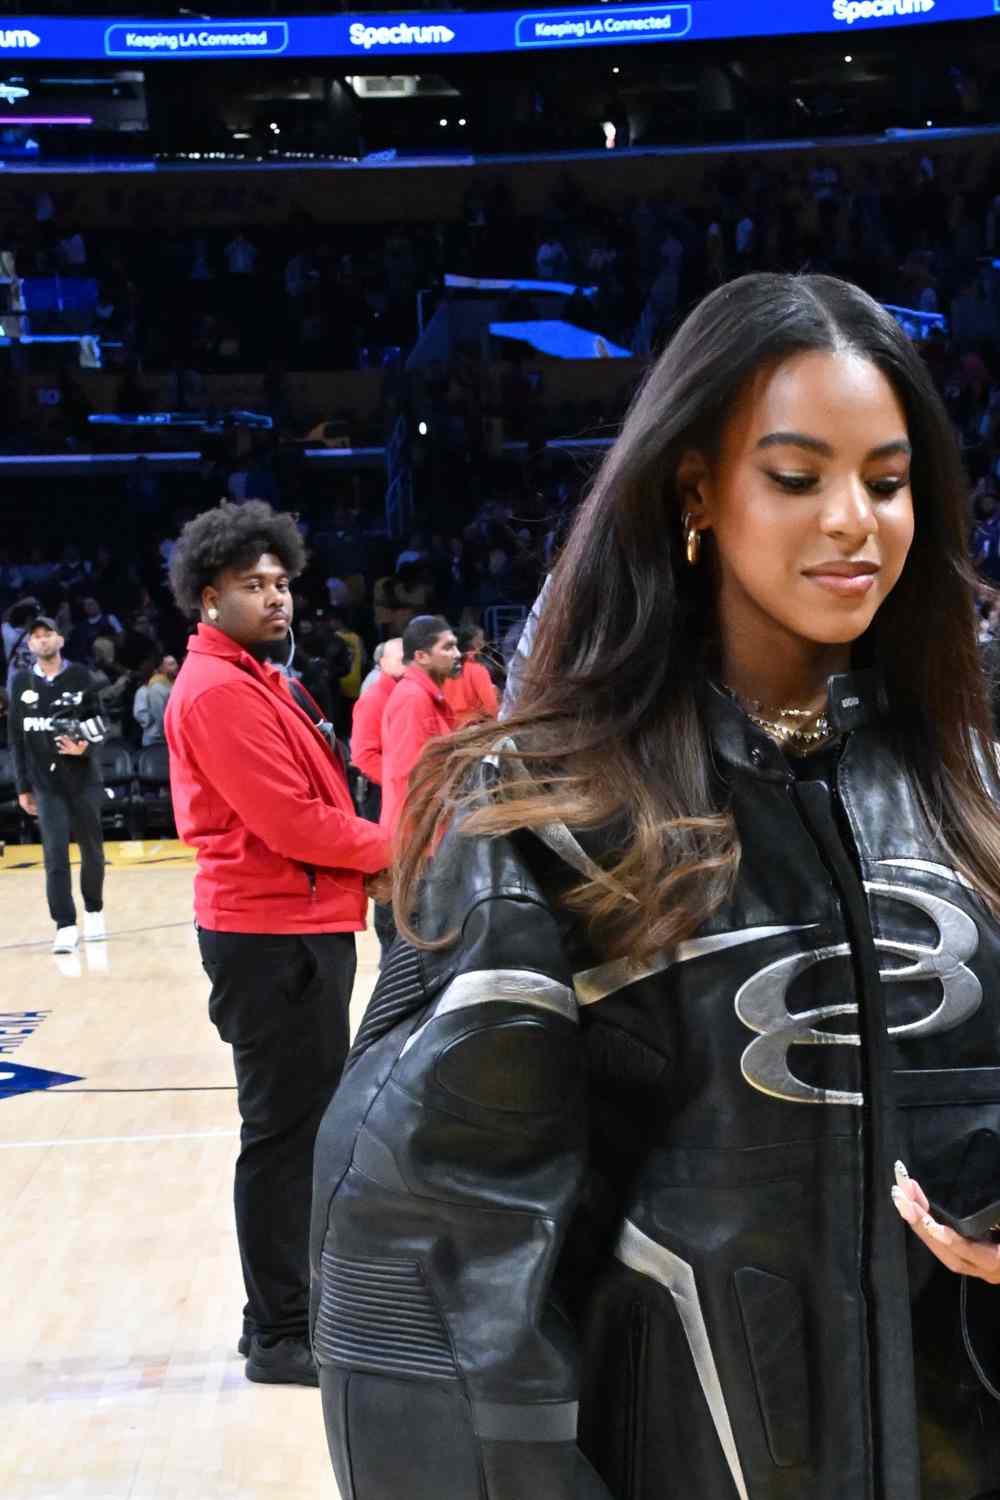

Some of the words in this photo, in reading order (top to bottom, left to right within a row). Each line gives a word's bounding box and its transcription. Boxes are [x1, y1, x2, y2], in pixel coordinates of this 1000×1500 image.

[349, 22, 451, 49] Spectrum
[535, 21, 584, 37] Keeping
[585, 19, 603, 34] LA
[604, 14, 671, 32] Connected
[126, 32, 178, 50] Keeping
[179, 33, 198, 47] LA
[198, 31, 267, 46] Connected
